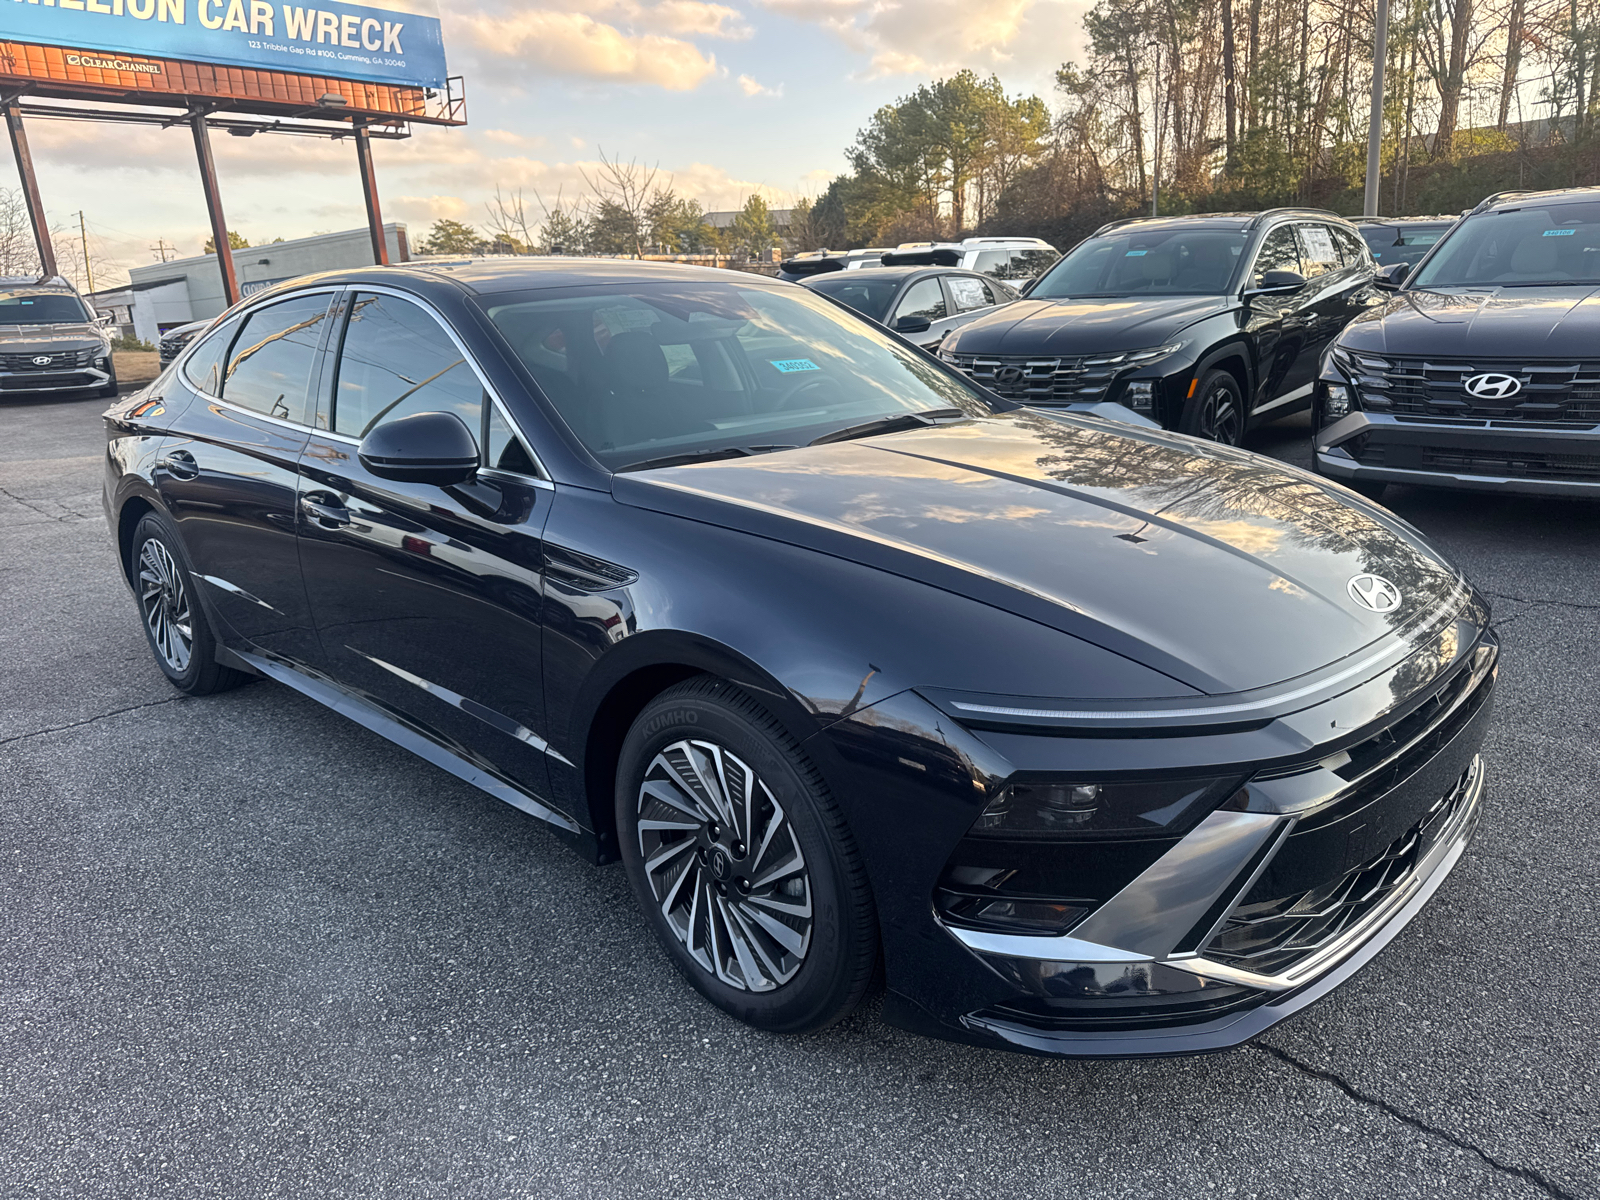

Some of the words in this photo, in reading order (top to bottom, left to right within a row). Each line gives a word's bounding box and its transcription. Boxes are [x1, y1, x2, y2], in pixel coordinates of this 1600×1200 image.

[198, 0, 274, 37] CAR
[283, 5, 404, 55] WRECK
[248, 40, 262, 49] 123
[263, 42, 288, 53] Tribble
[289, 45, 304, 56] Gap
[305, 47, 316, 56] Rd
[317, 49, 337, 59] #100,
[338, 52, 372, 64] Cumming,
[372, 57, 383, 65] GA
[384, 58, 406, 68] 30040
[642, 710, 699, 739] KUMHO
